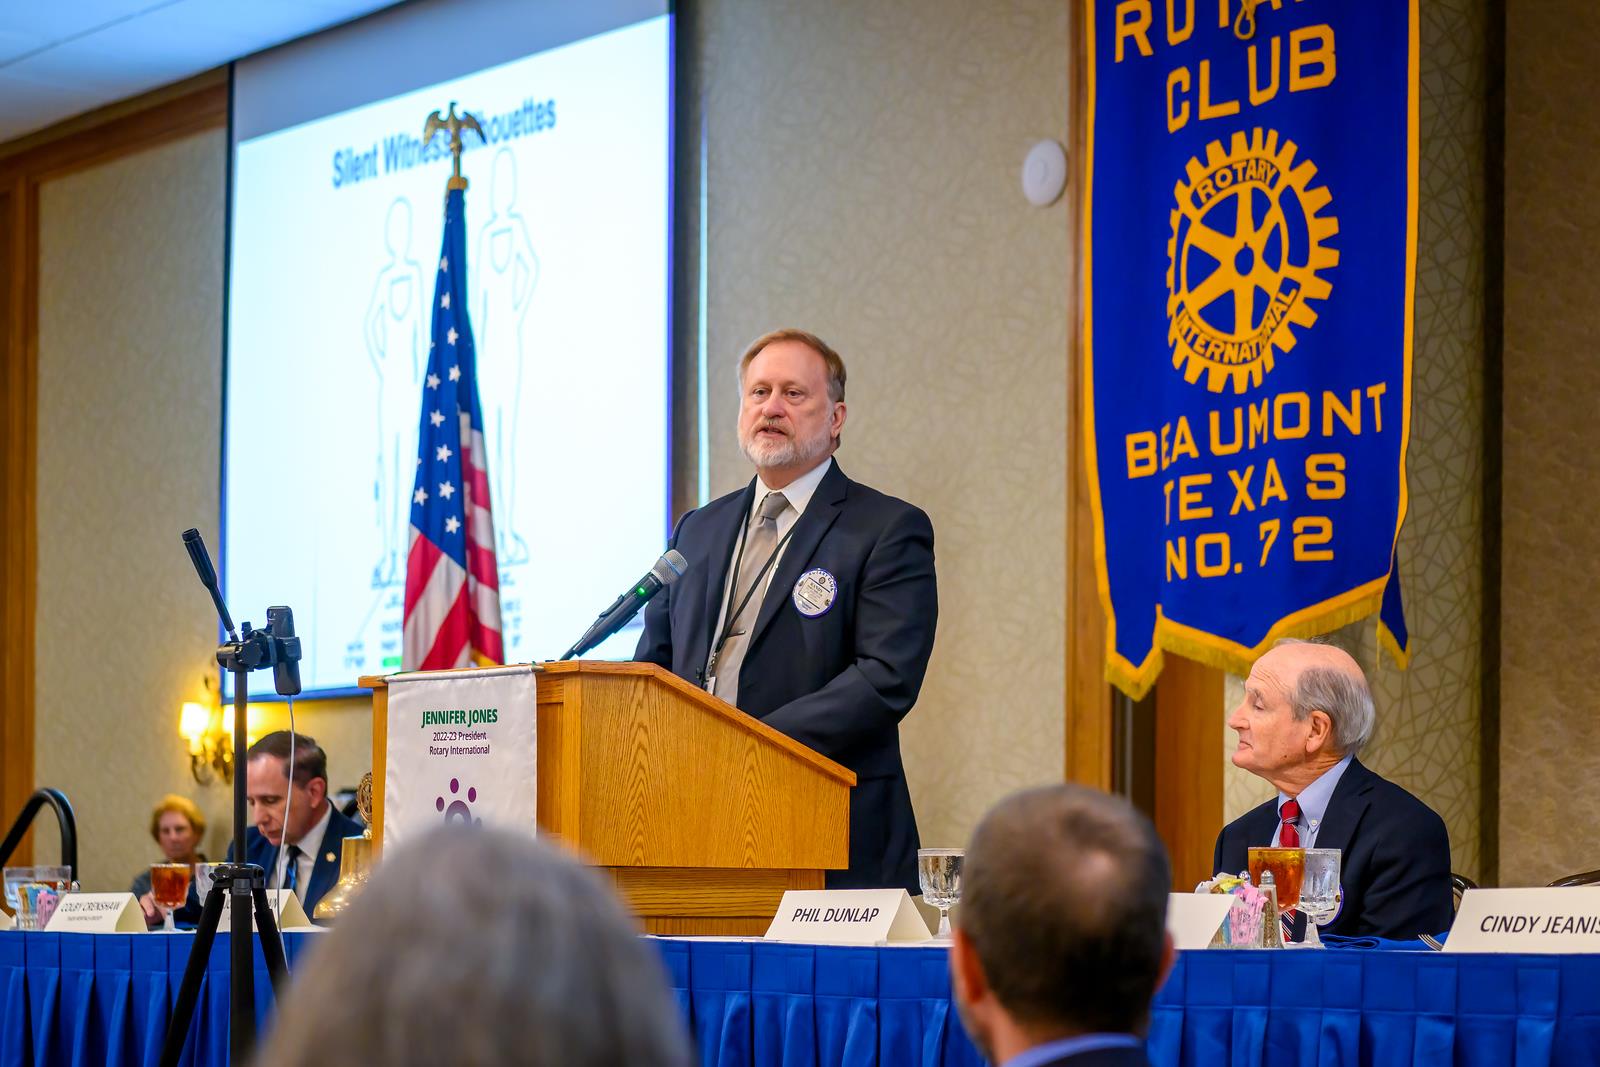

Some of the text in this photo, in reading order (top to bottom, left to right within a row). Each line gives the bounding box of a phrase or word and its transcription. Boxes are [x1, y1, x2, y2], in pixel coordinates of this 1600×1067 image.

[1166, 23, 1337, 134] CLUB
[332, 143, 378, 188] Silent
[458, 98, 556, 152] ilhouettes
[1196, 158, 1278, 203] ROTARY
[1176, 287, 1298, 365] INTERNATNAL
[1125, 382, 1387, 479] BEAUMONT
[1164, 453, 1346, 526] TEXAS
[1166, 516, 1334, 582] NO. 72
[421, 708, 498, 728] JENNIFER JONES
[432, 730, 487, 742] 2022-23 President
[429, 744, 490, 758] Rotary International
[791, 907, 880, 923] PHIL DUNLAP
[1480, 915, 1541, 933] CINDY
